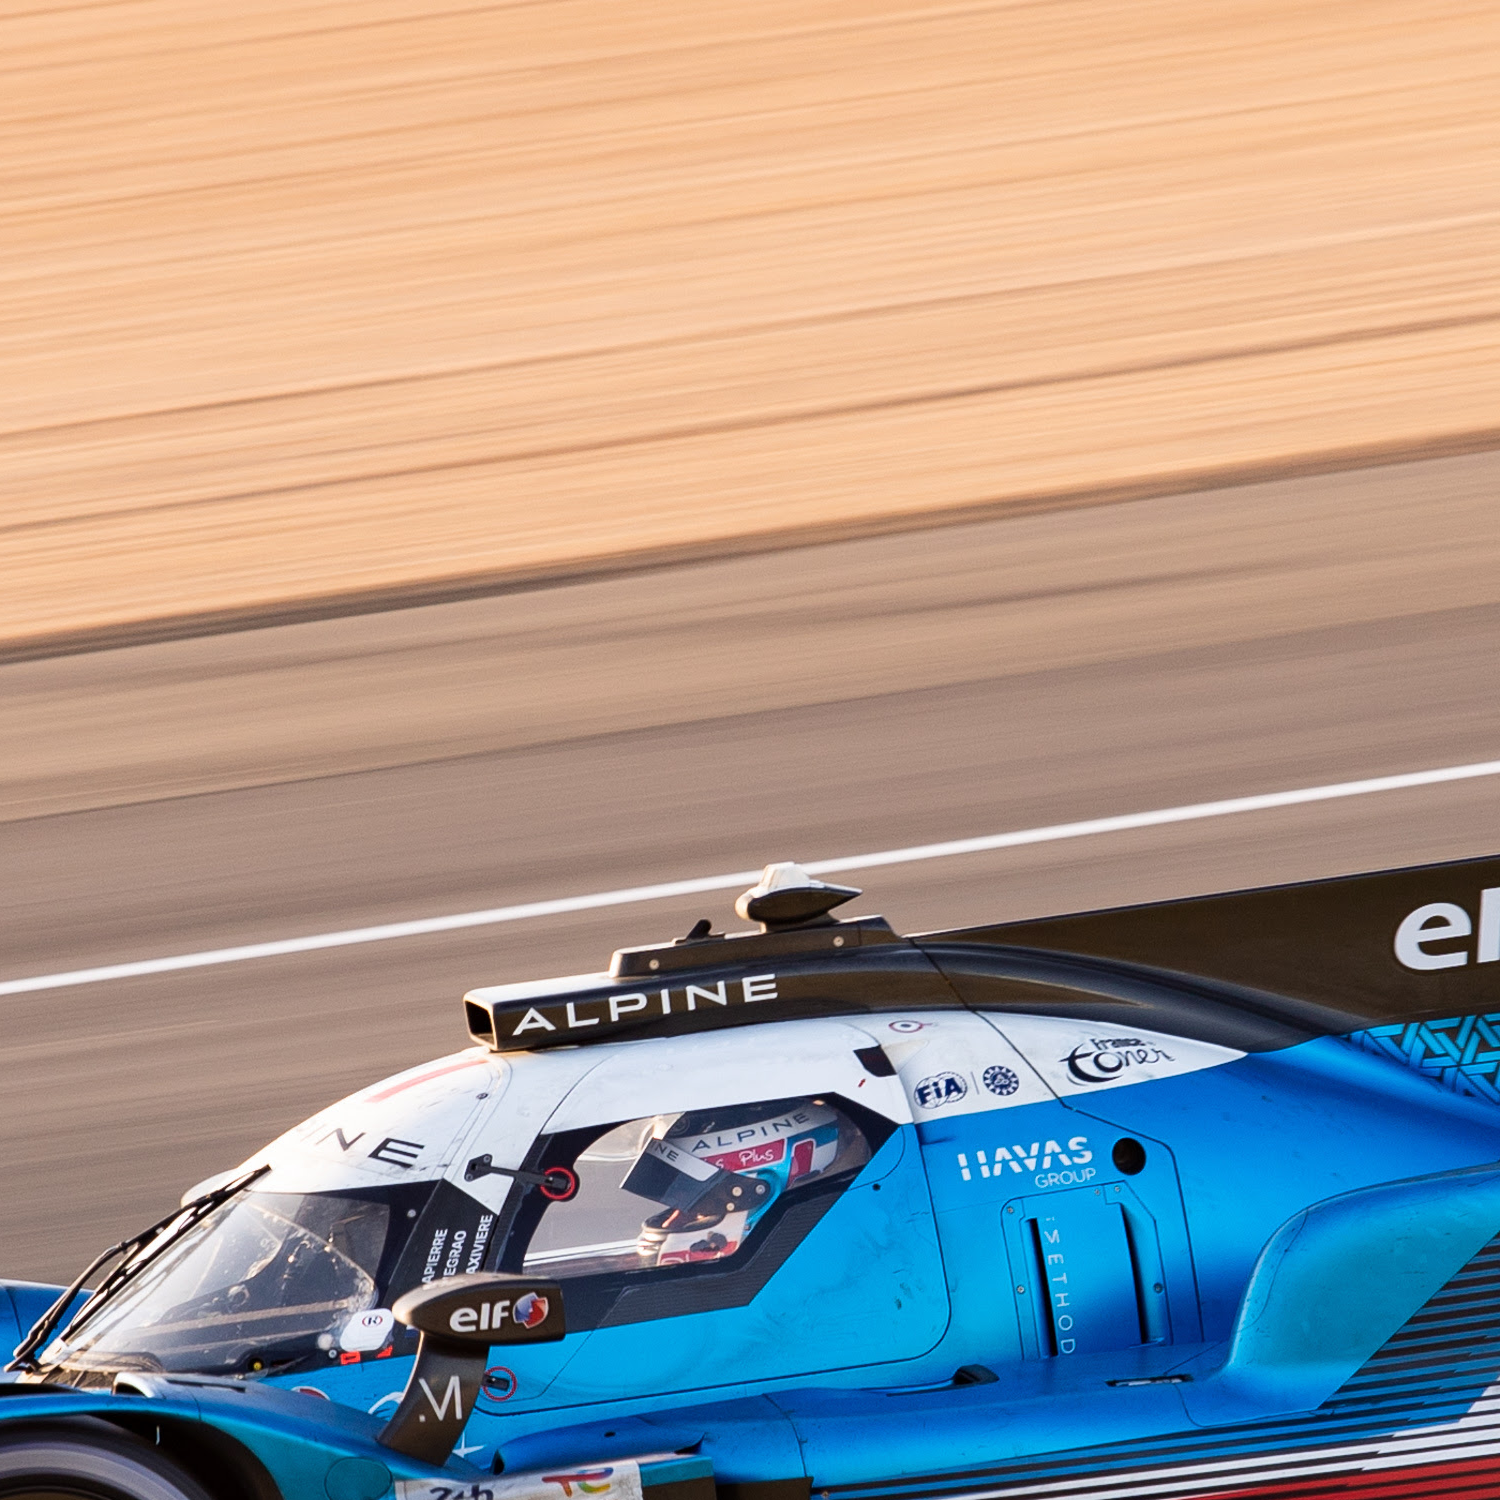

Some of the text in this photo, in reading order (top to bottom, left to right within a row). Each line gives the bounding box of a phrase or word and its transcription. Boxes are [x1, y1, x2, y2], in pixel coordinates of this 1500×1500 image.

[512, 973, 779, 1036] ALPINE
[691, 1112, 810, 1153] ALPINE
[739, 1149, 774, 1166] Plus
[957, 1136, 1093, 1181] HAVAS
[1034, 1168, 1096, 1188] GROUP
[421, 1228, 448, 1284] APIERRE
[466, 1214, 494, 1275] AXIVIERE
[1044, 1228, 1077, 1354] METHOD
[450, 1300, 510, 1333] elf
